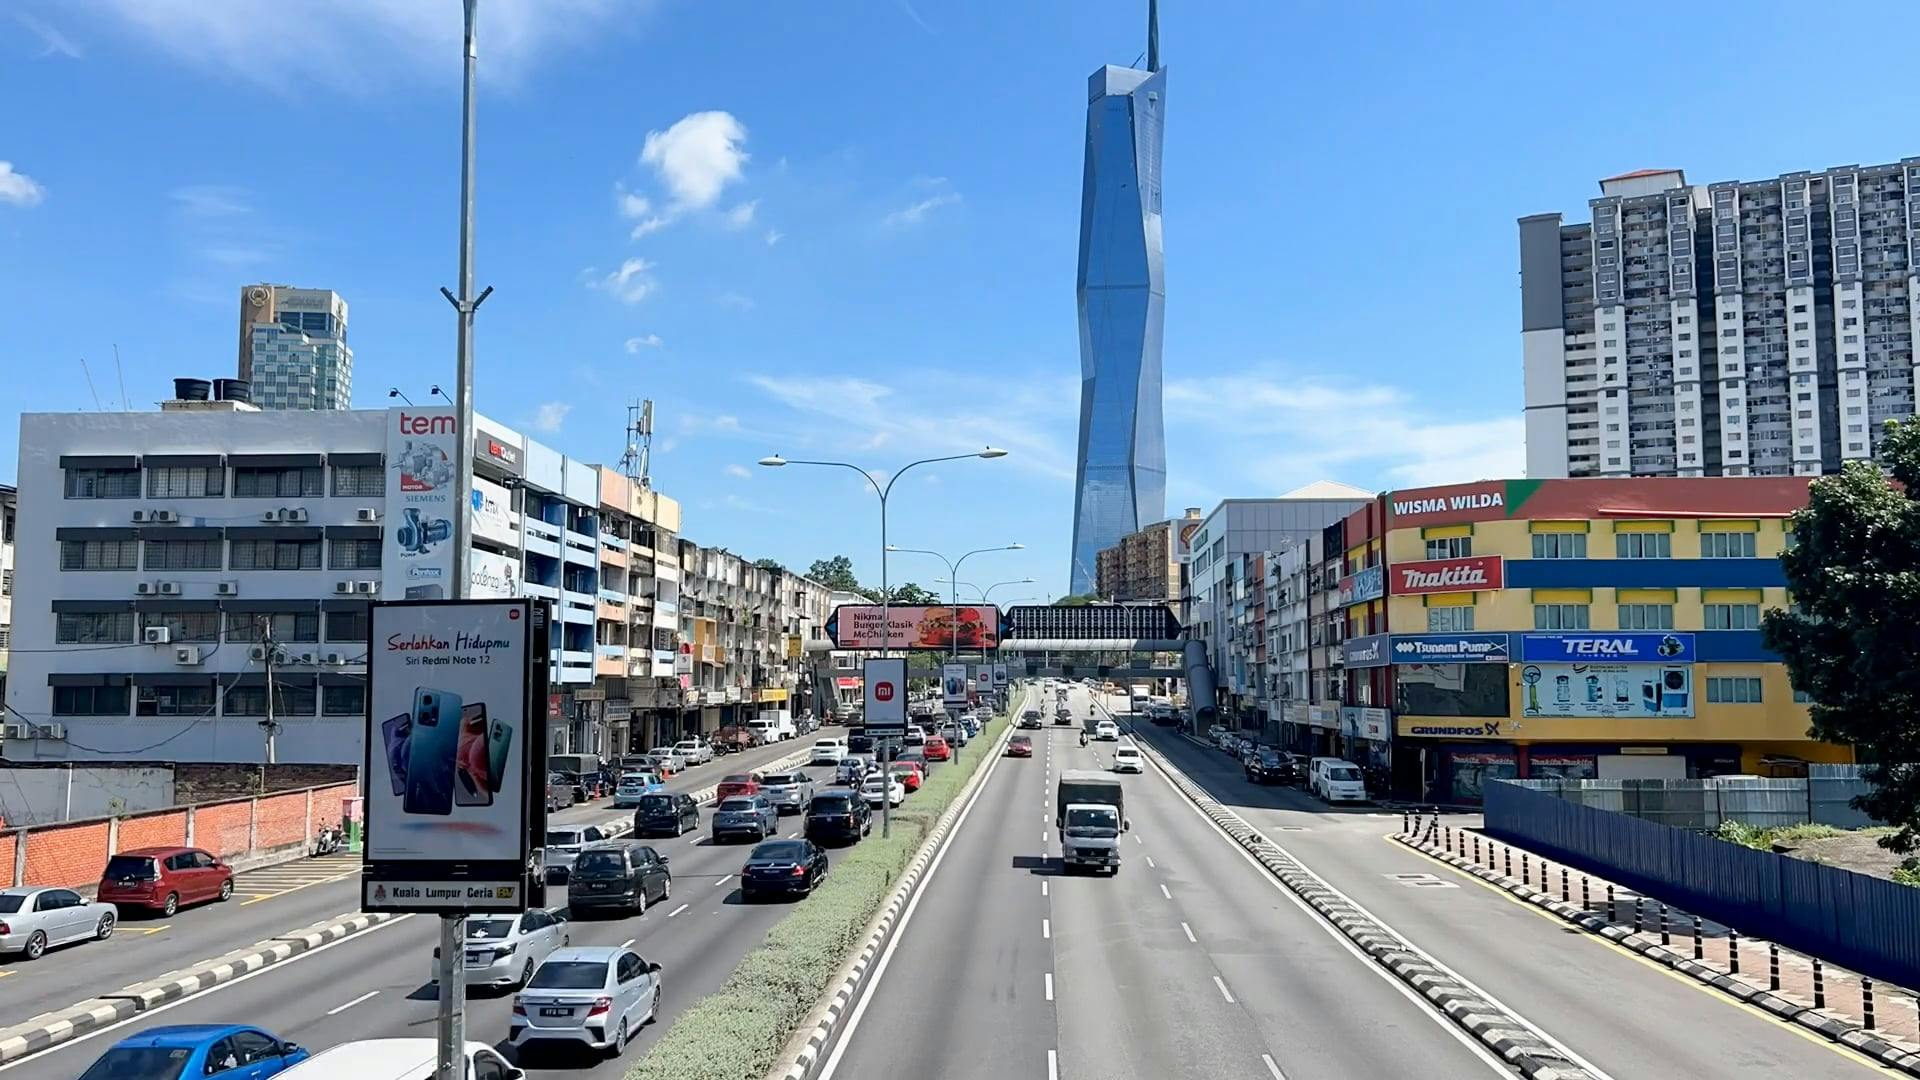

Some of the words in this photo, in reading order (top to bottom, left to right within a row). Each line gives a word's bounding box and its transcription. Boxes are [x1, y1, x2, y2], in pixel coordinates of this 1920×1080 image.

[400, 412, 456, 435] tem
[406, 494, 446, 503] SIEMENS
[1393, 498, 1447, 515] WISMA
[1450, 492, 1504, 511] WILDA
[854, 621, 884, 630] Burger
[853, 630, 904, 639] McChiken
[387, 632, 450, 651] Serlahkan
[455, 630, 510, 653] Hidupmu
[1562, 639, 1639, 654] TERAL
[405, 656, 420, 665] Siri
[422, 655, 450, 665] Redmi
[453, 655, 477, 665] Note
[479, 655, 490, 664] 12
[1411, 726, 1484, 736] GRUNDFOS
[393, 887, 420, 898] Kuala
[426, 887, 461, 899] Lumpur
[467, 887, 493, 898] Ceria
